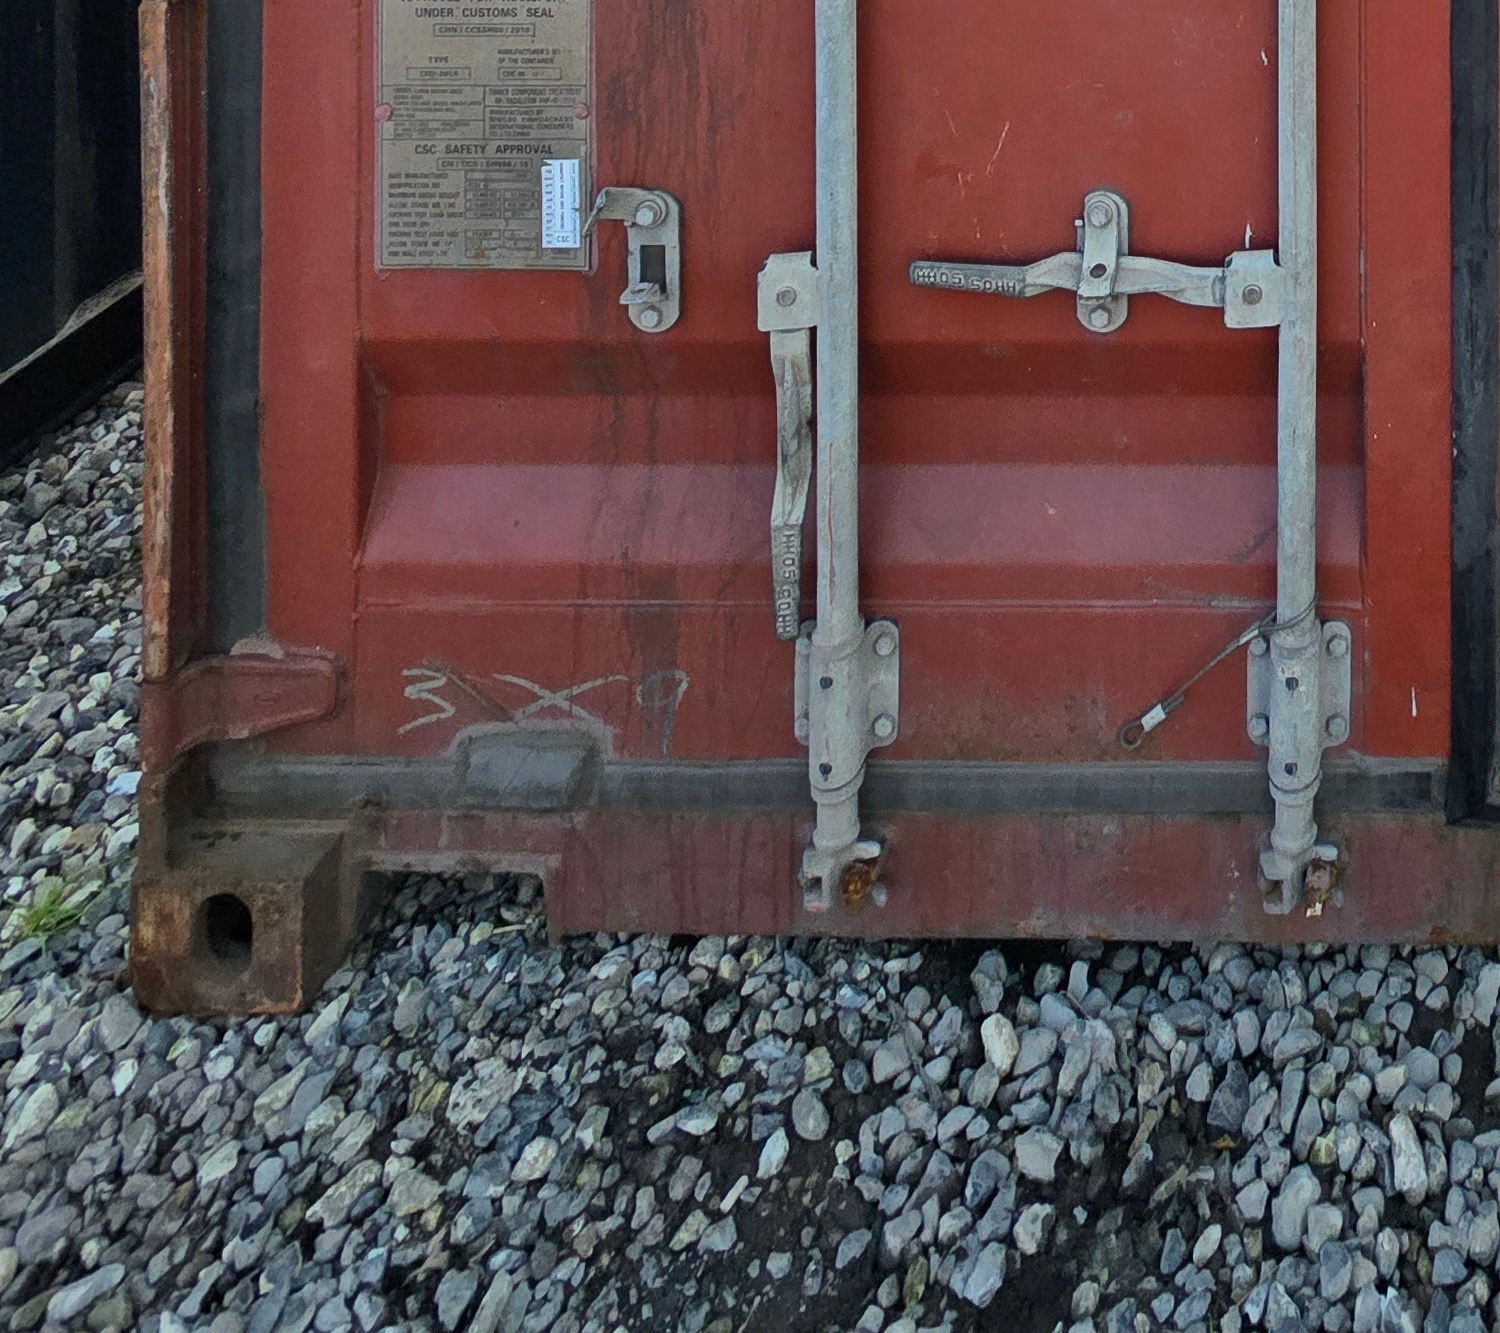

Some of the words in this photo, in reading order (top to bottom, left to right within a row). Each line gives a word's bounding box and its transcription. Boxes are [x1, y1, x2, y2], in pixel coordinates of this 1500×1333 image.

[415, 7, 454, 18] UNDER
[462, 7, 518, 18] CUSTOMS
[526, 7, 555, 18] SEAL
[415, 144, 436, 155] CSC
[445, 143, 487, 155] SAFETY
[495, 144, 553, 155] APPROVAL
[556, 235, 570, 243] CSC
